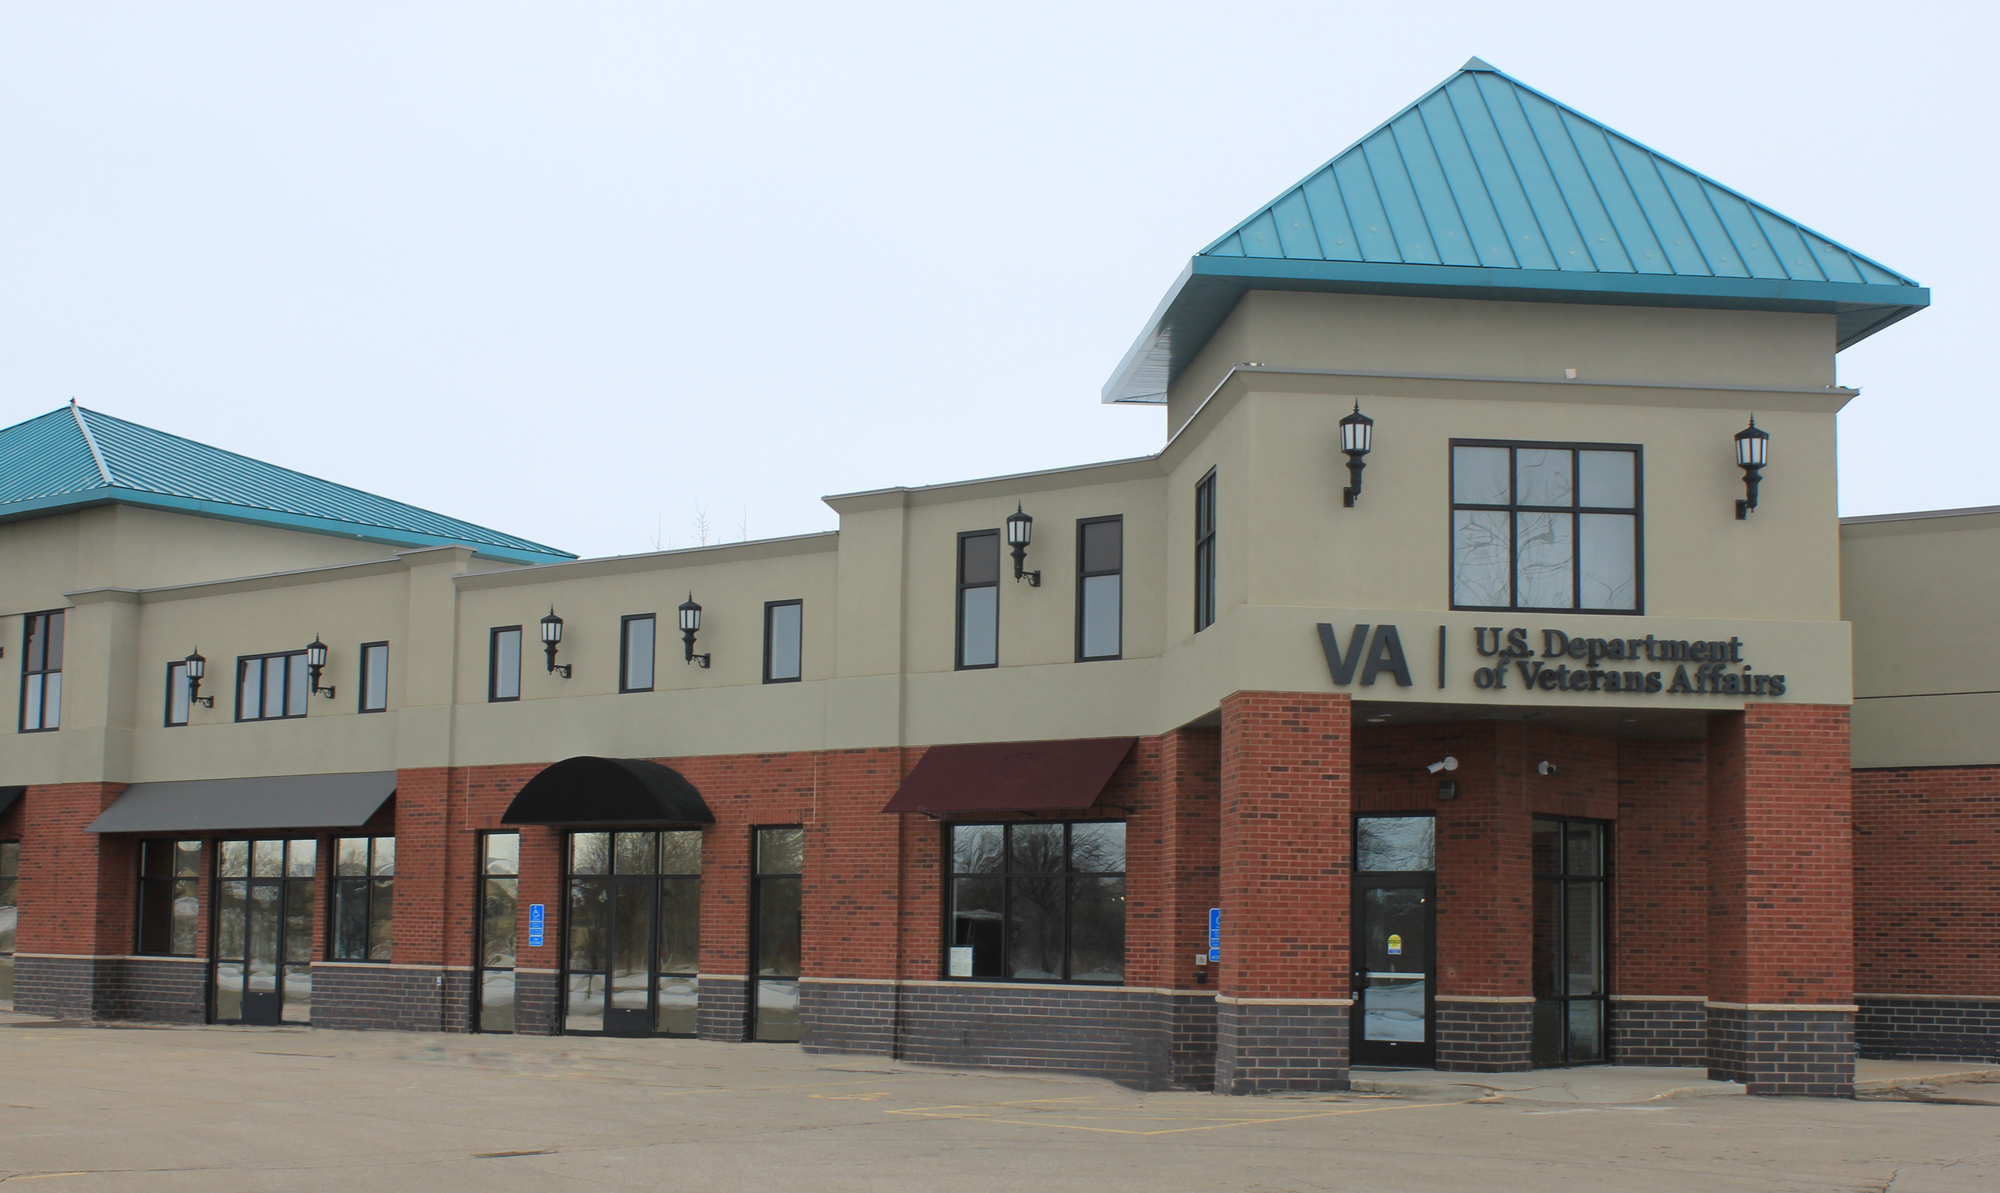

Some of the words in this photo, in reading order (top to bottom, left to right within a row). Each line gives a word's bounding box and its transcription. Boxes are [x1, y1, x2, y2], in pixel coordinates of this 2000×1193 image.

[1316, 623, 1413, 686] VA
[1473, 627, 1535, 658] U.S.
[1541, 629, 1744, 667] Department
[1473, 658, 1511, 689] of
[1516, 660, 1662, 693] Veterans
[1666, 663, 1786, 696] Affairs
